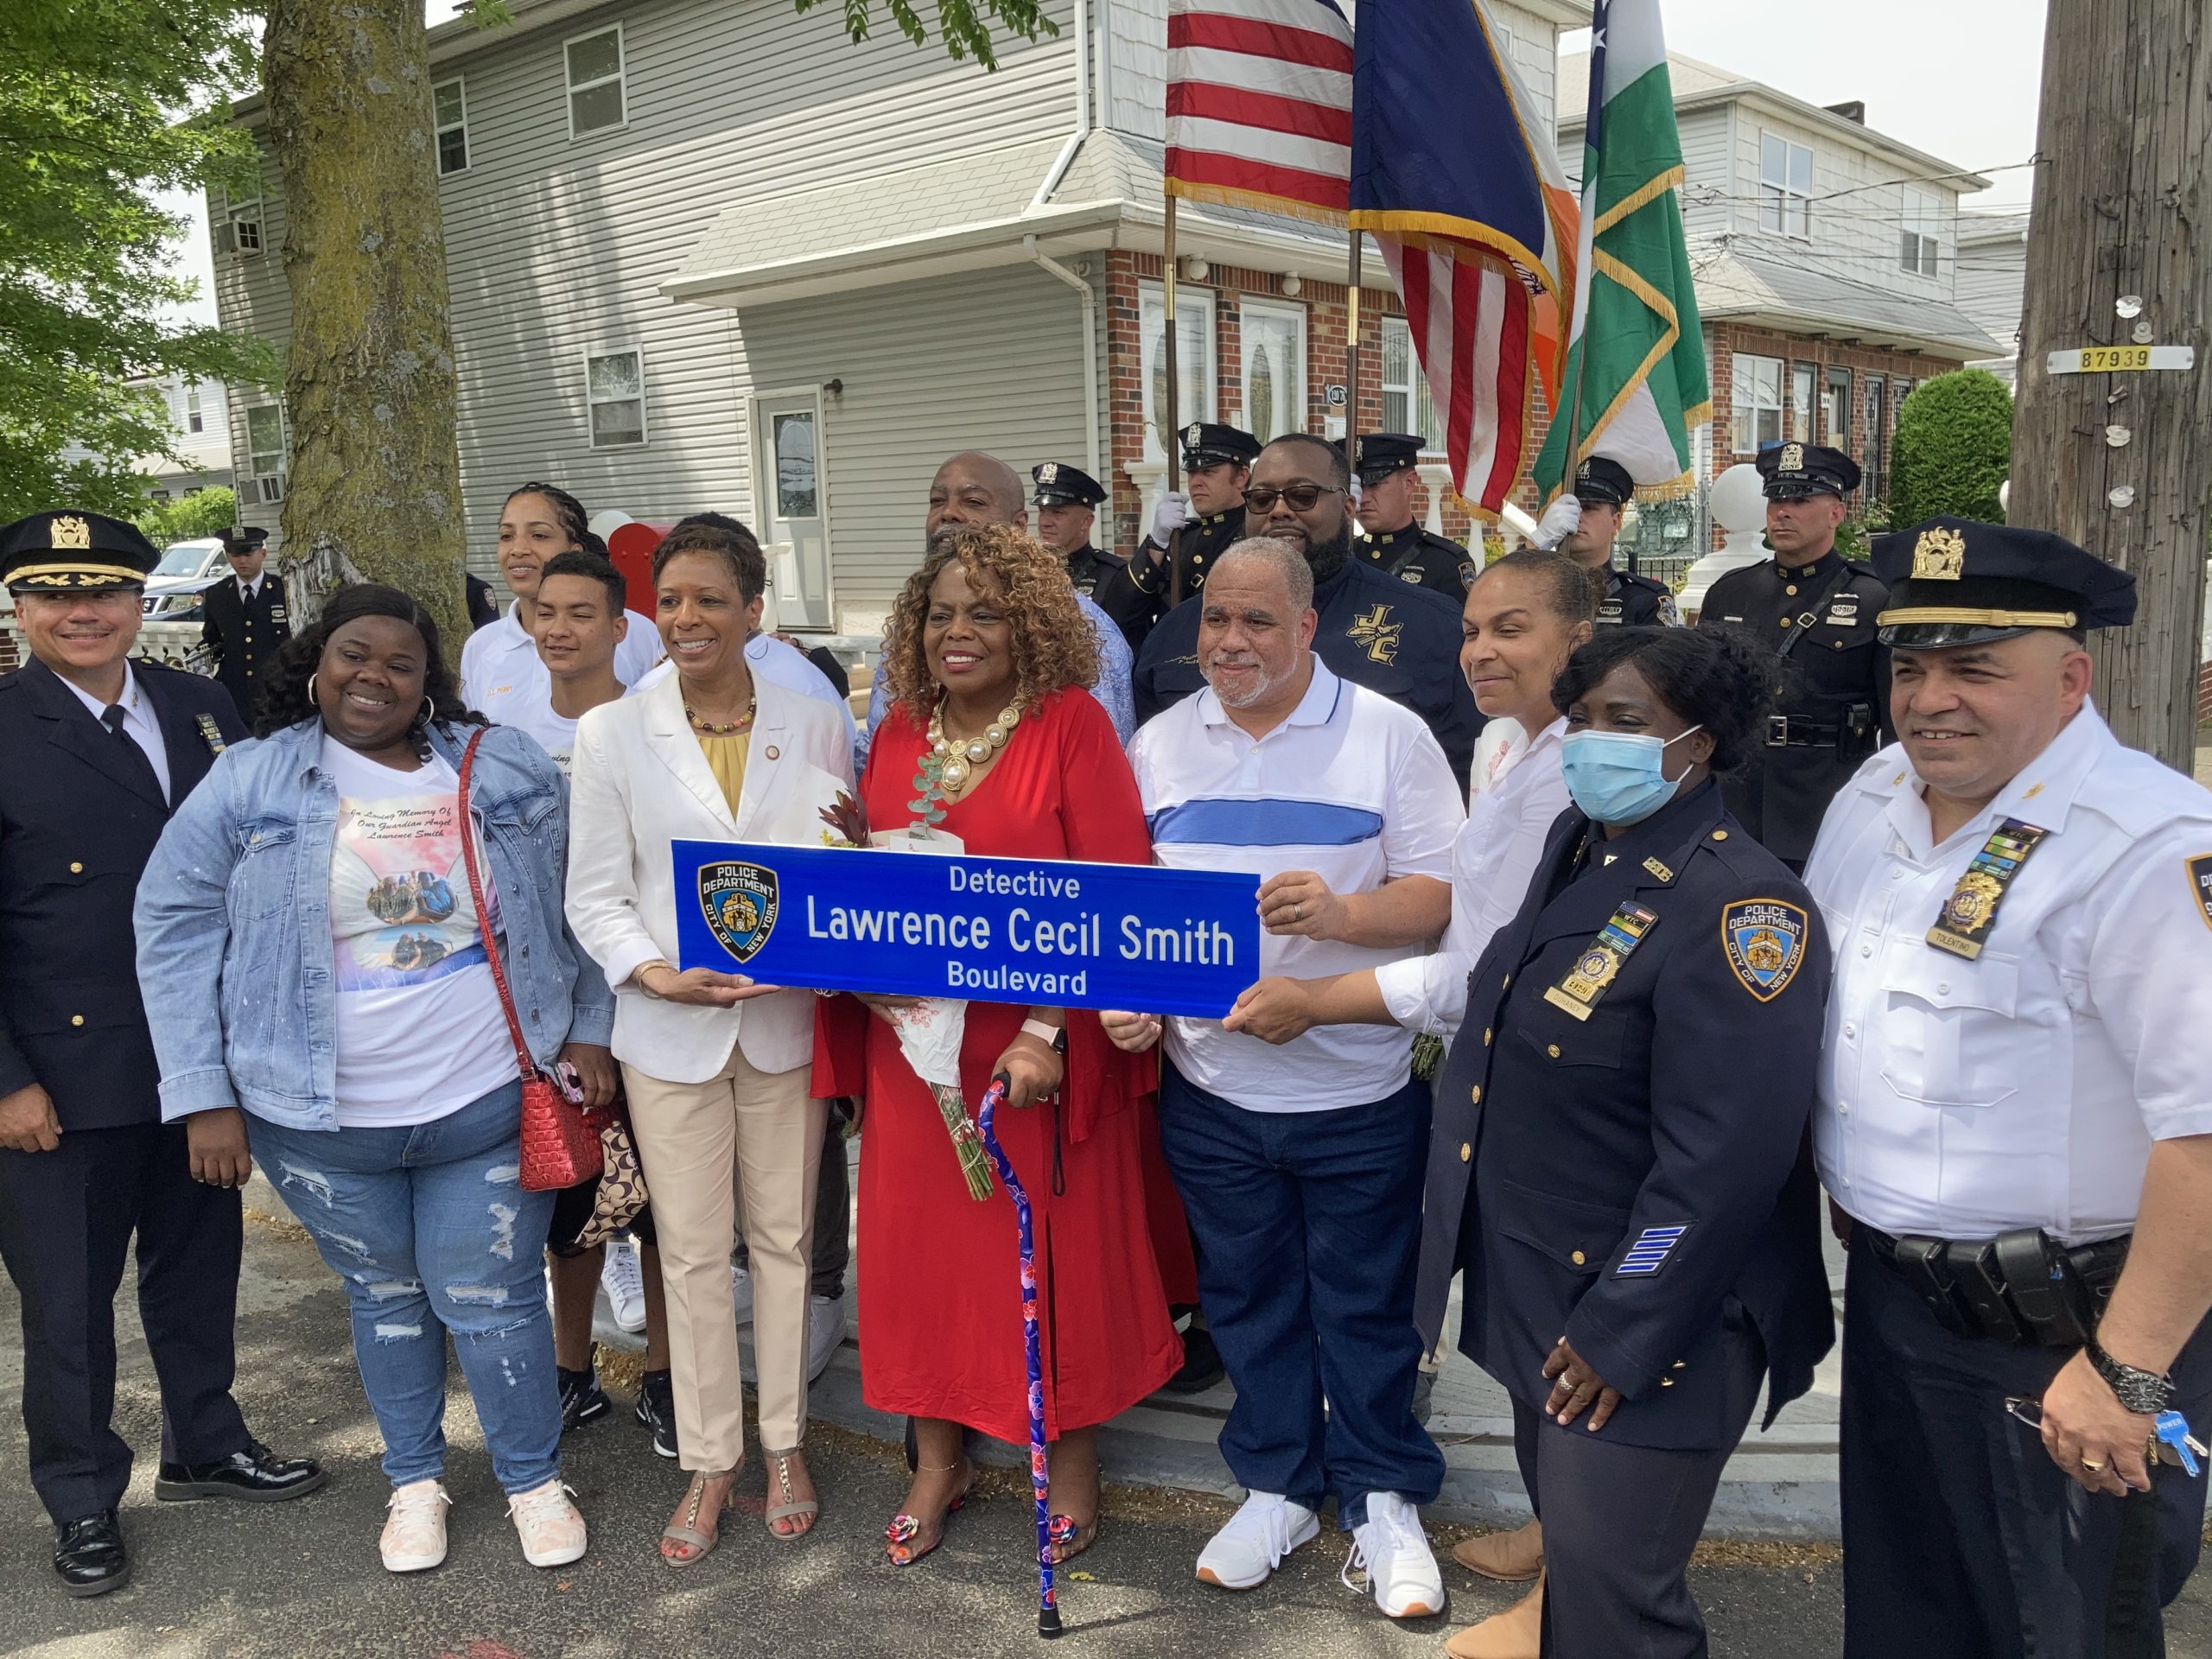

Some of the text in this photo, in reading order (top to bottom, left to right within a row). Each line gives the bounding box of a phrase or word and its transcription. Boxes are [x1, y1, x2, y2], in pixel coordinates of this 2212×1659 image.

[2082, 350, 2148, 368] 87939
[552, 754, 570, 766] ving
[351, 809, 361, 817] In
[364, 811, 395, 821] Loving
[439, 807, 451, 817] Of
[357, 817, 452, 831] Our Guardian Angel
[415, 830, 444, 838] Smith
[717, 866, 759, 880] POLICE
[950, 867, 1080, 899] Detective
[702, 877, 774, 898] DEPARTMENT
[1624, 914, 1639, 925] WTC
[1745, 905, 1787, 918] POLICE
[705, 903, 776, 952] CITY OF NEW YORK
[808, 896, 1233, 965] Lawrence Cecil Smith
[1729, 915, 1802, 935] DEPARTMENT
[1936, 932, 1970, 952] TOLENTINO
[1728, 942, 1801, 990] CITY OF NEW YORK
[948, 961, 1085, 995] Boulevard
[1553, 993, 1580, 1013] DUHANEY
